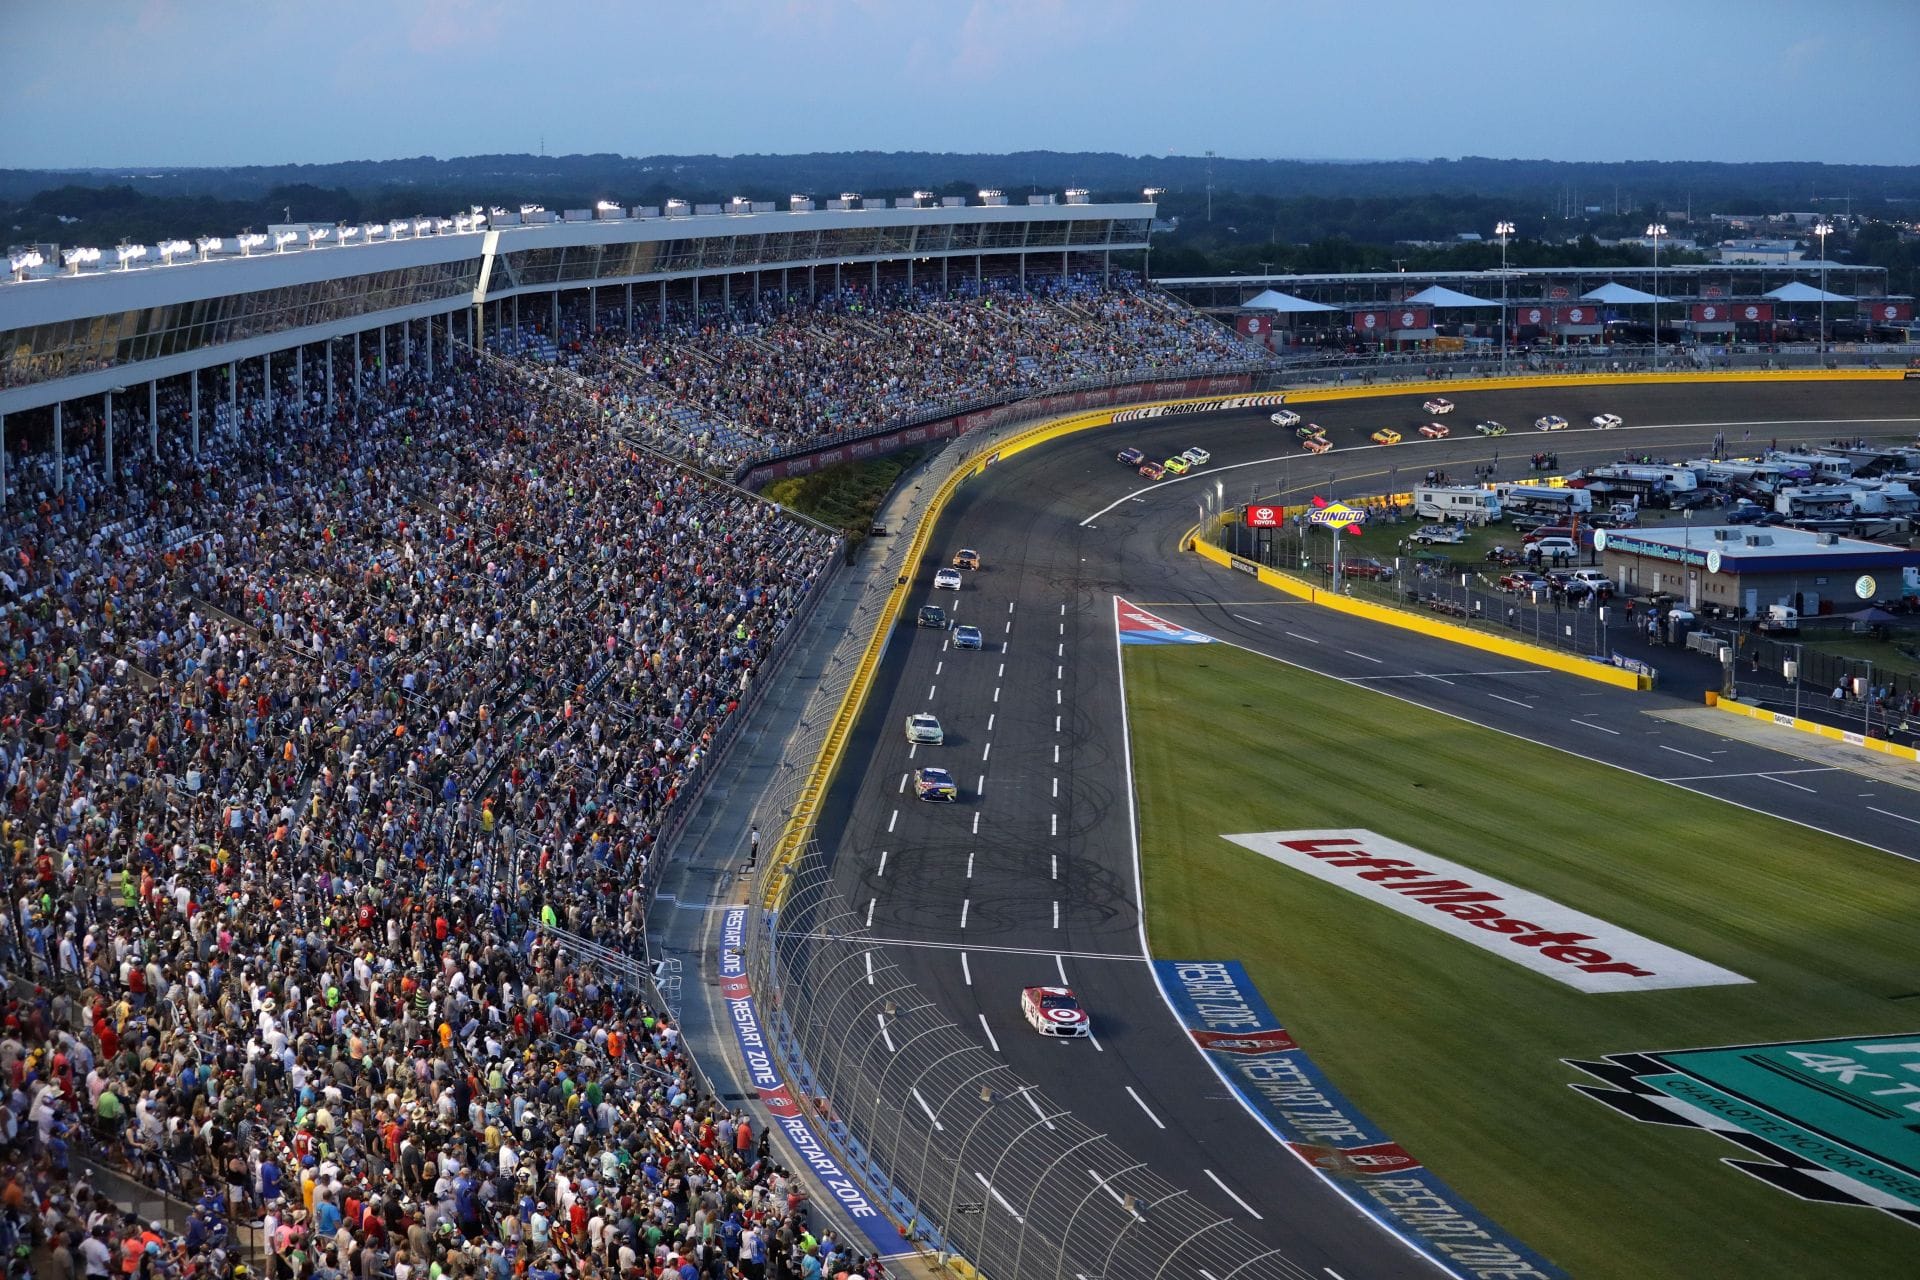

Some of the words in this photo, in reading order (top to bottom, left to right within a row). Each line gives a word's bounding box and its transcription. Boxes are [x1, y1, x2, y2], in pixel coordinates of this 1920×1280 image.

[1164, 383, 1186, 392] TOYOTA
[1217, 379, 1239, 388] TOYOTA
[1161, 401, 1225, 415] CHARLOTTE
[1313, 511, 1363, 522] SUNOCO
[1277, 838, 1657, 978] LiftMaster
[726, 910, 744, 948] RESTART
[724, 948, 740, 973] ZONE
[1174, 962, 1244, 1002] RESTART
[1196, 1002, 1262, 1028] ZONE
[731, 1001, 763, 1048] RESTART
[748, 1051, 777, 1084] ZONE
[1233, 1058, 1334, 1108] RESTART
[1786, 1050, 1895, 1085] 4K
[1280, 1108, 1368, 1141] ZONE
[1665, 1079, 1788, 1134] CHARLOTTE
[1779, 1133, 1865, 1169] MOTOR
[782, 1119, 842, 1178] RESTART
[828, 1178, 877, 1218] ZONE
[1355, 1178, 1492, 1240] RESTART
[1434, 1241, 1551, 1280] ZONE
